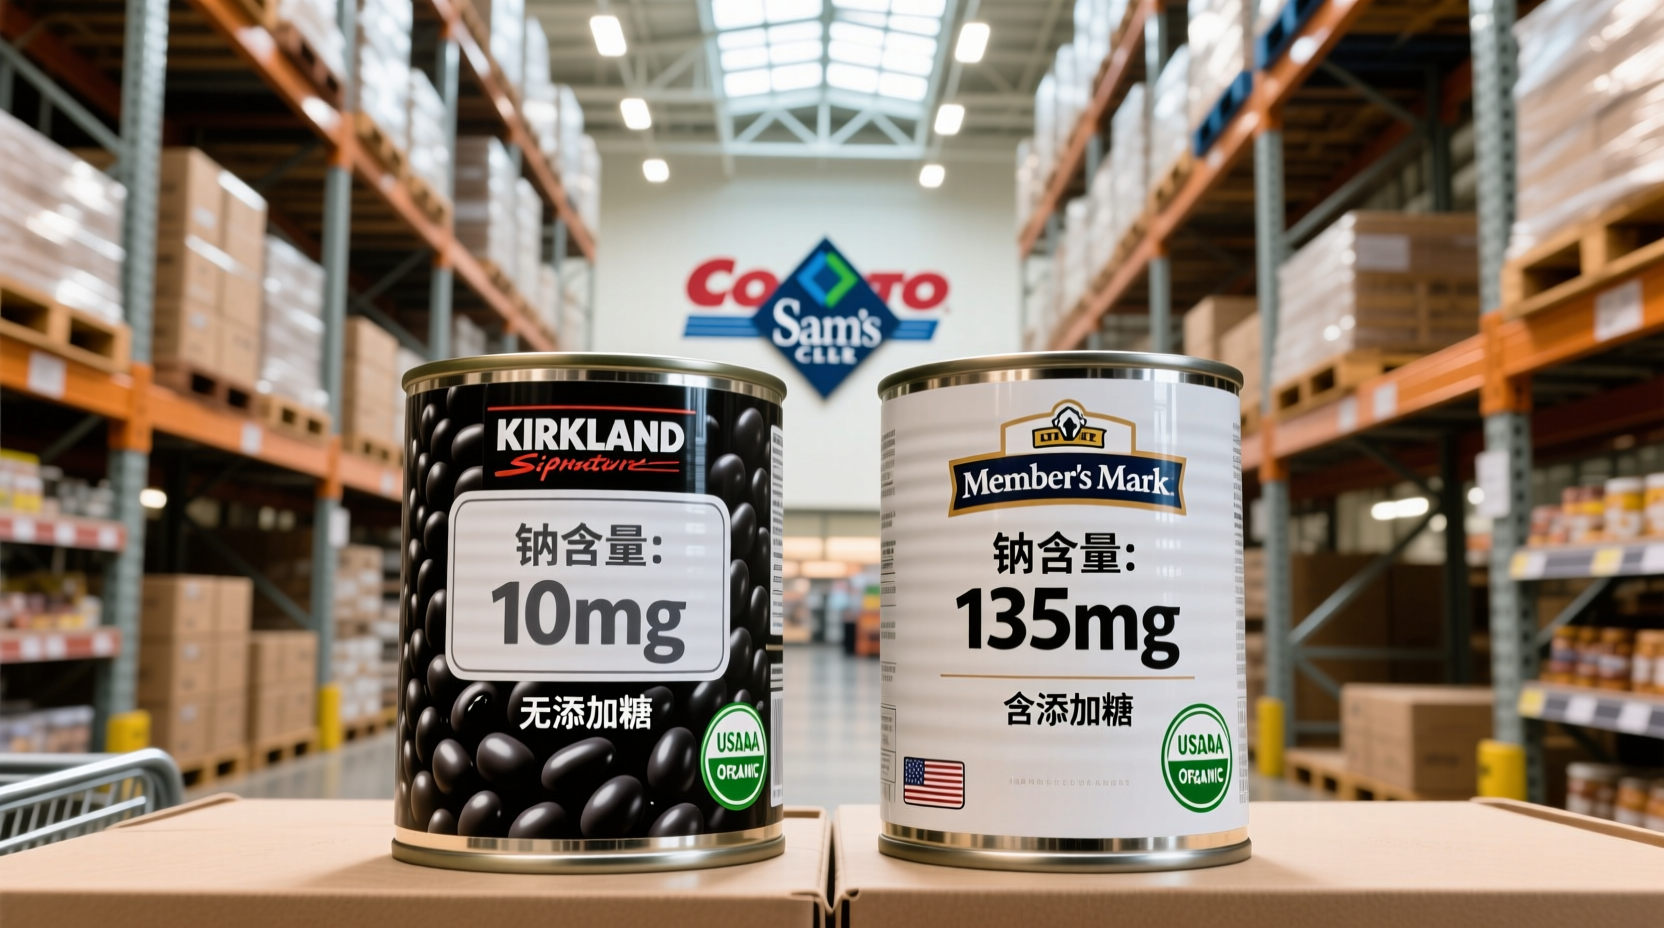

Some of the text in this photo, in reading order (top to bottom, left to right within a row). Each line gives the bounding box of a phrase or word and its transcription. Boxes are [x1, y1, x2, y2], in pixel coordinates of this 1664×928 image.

[772, 297, 882, 348] Sam's
[497, 417, 685, 453] KIRKLAND
[962, 462, 1092, 499] Member's
[515, 522, 662, 567] 钠含量:
[993, 531, 1135, 574] 钠含量:
[491, 579, 687, 664] 10mg
[956, 586, 1180, 669] 135mg
[519, 694, 653, 730] 无添加糖
[1003, 691, 1134, 727] 含添加糖
